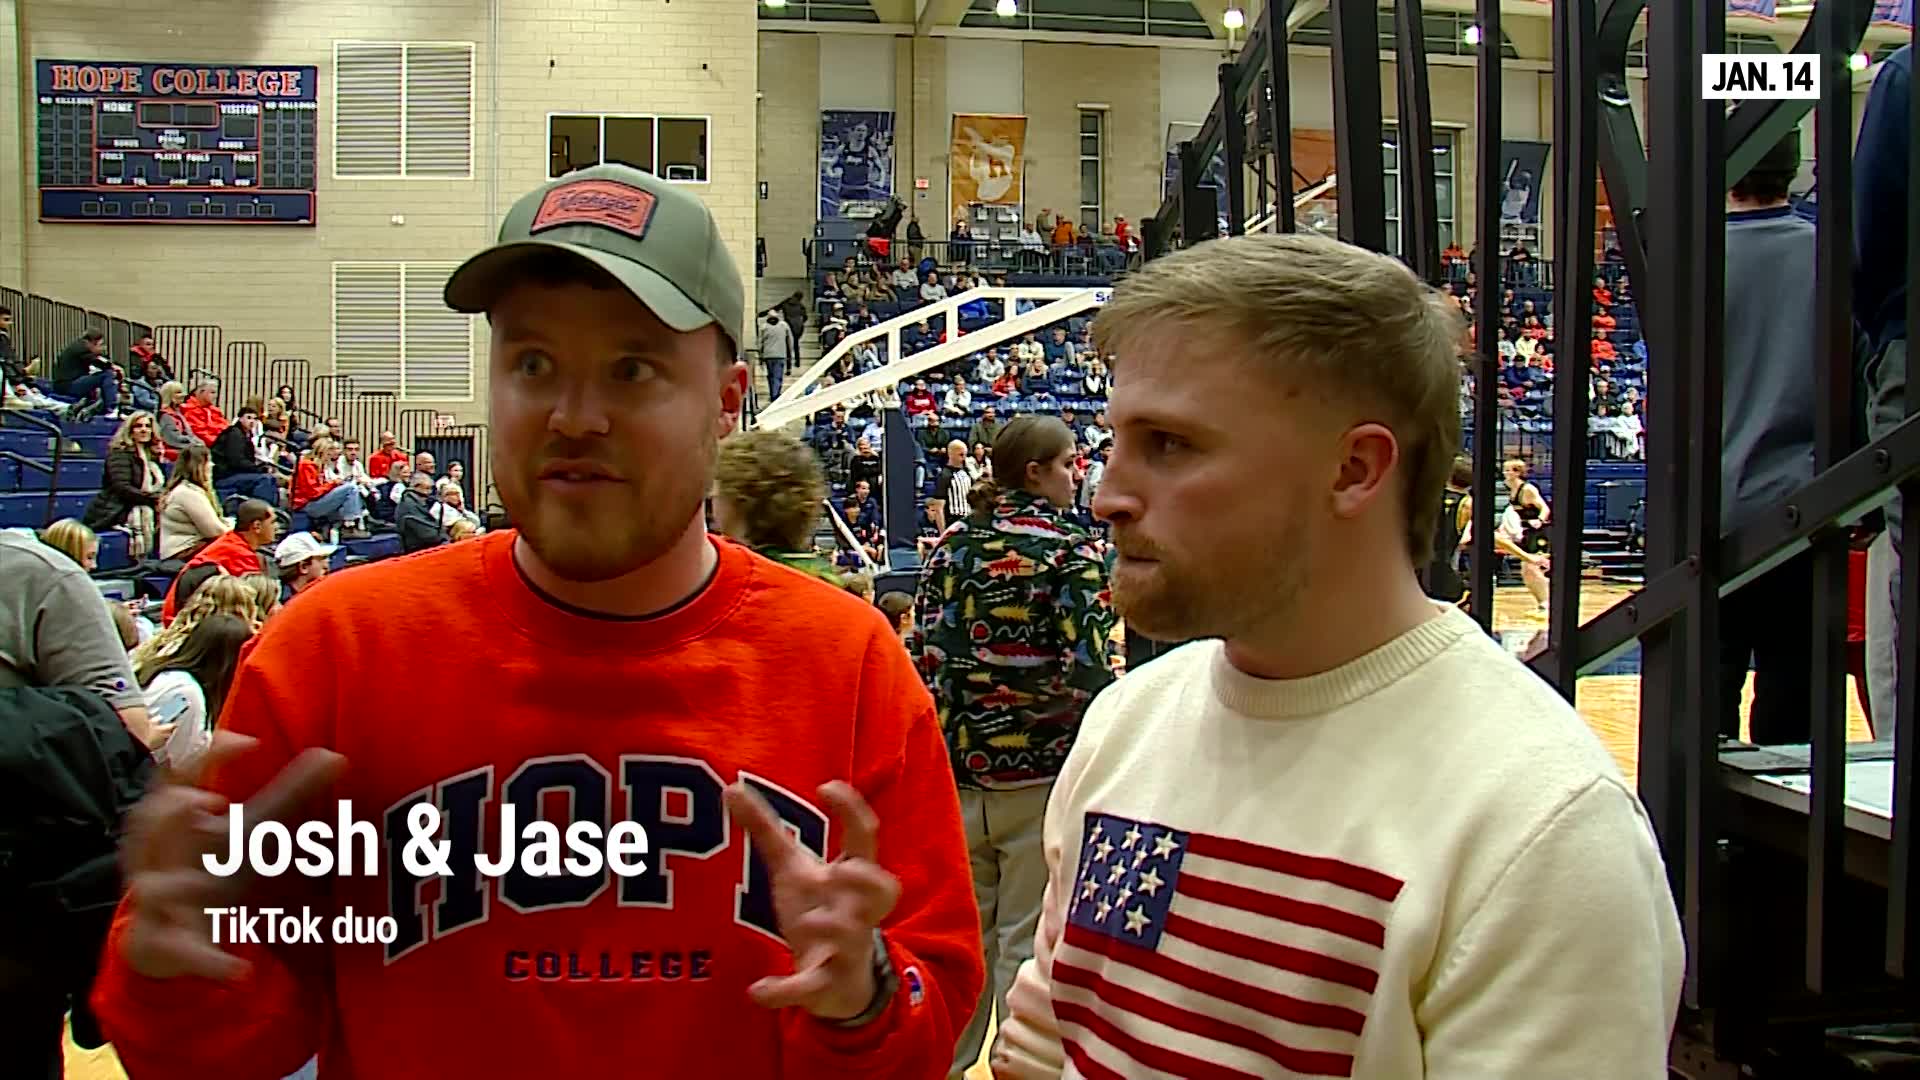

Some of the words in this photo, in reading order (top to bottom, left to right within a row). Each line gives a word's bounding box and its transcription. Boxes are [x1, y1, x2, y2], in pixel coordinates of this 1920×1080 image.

[51, 65, 142, 93] HOPE
[152, 68, 301, 96] COLLEGE
[102, 101, 134, 113] HOME
[220, 103, 259, 115] VISITOR
[504, 949, 713, 981] COLLEGE
